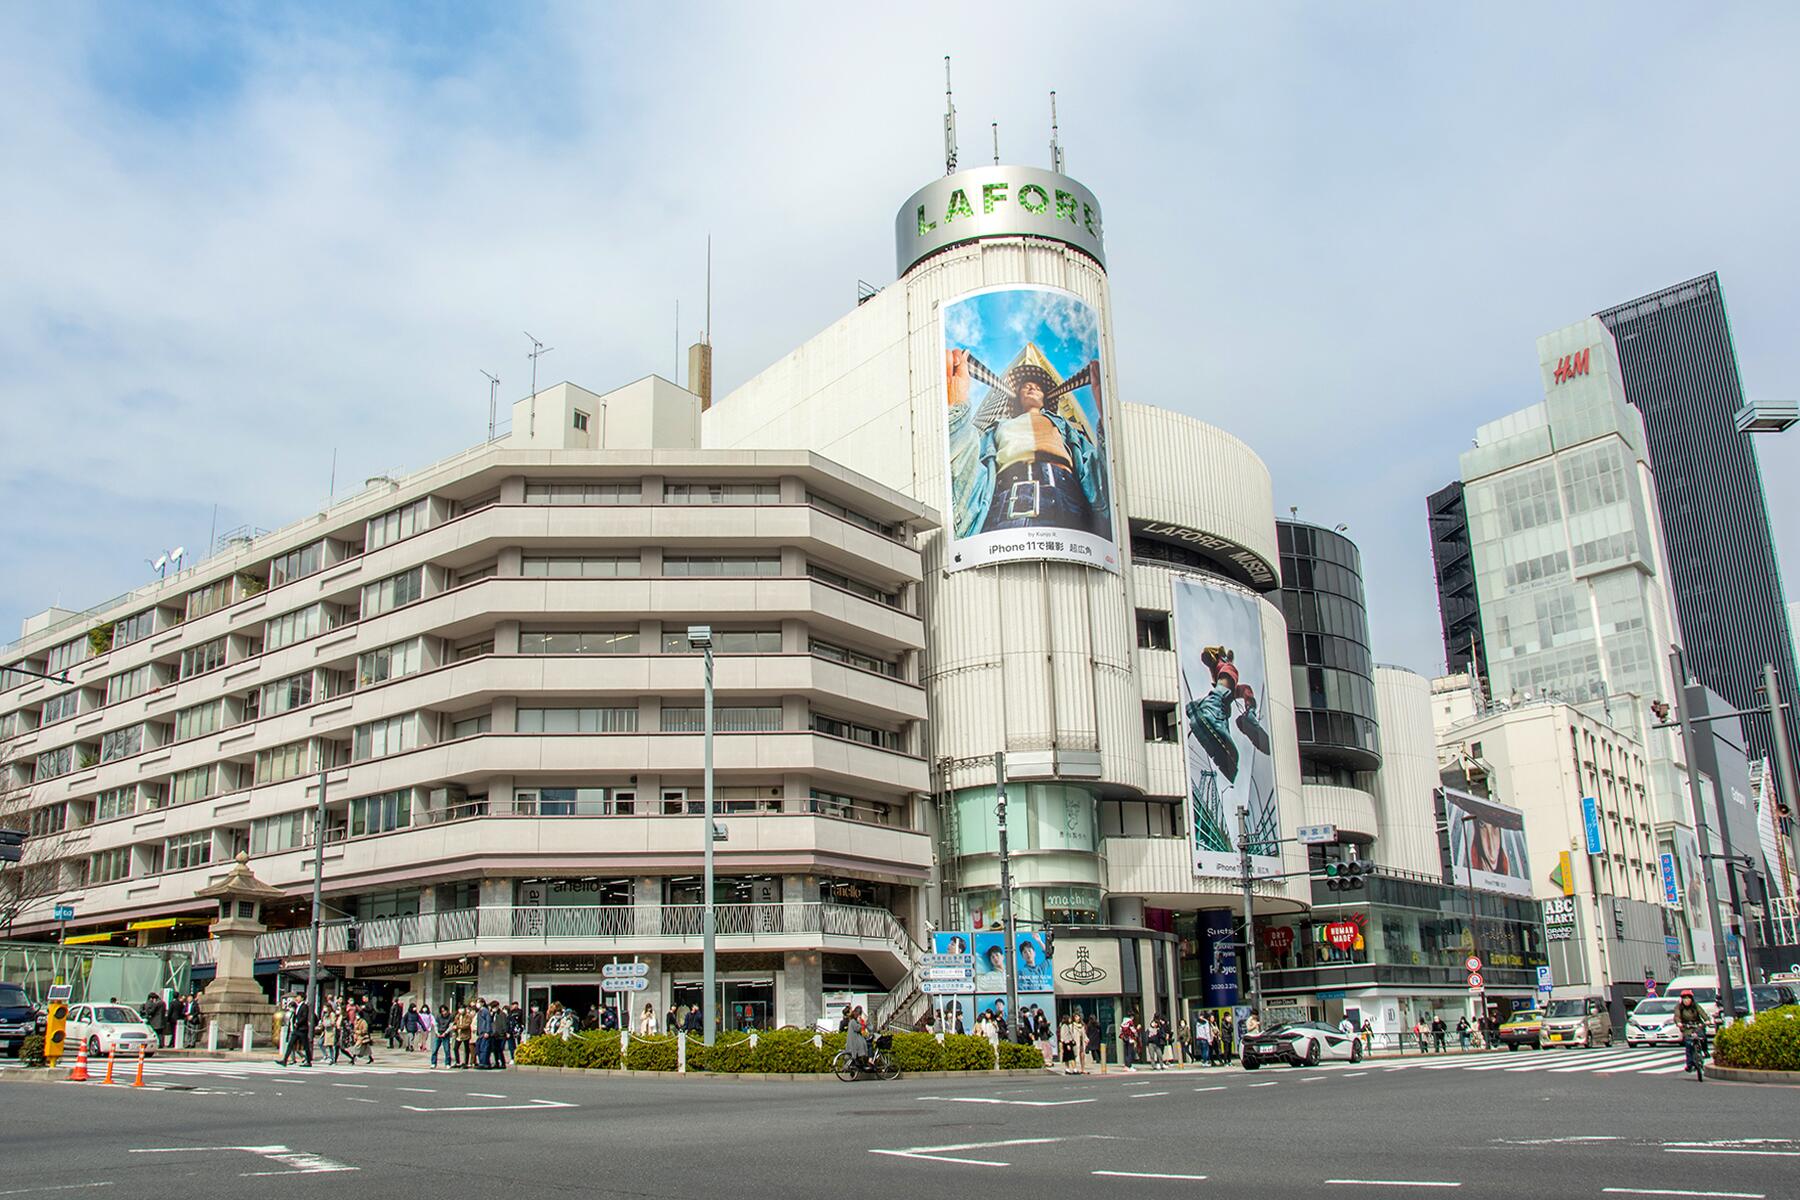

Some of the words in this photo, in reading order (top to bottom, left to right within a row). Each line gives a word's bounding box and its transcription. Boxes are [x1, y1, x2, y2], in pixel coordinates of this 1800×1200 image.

[1554, 348, 1590, 385] H&M
[989, 544, 1025, 555] iPhone
[1143, 523, 1234, 550] LAFORET
[1229, 551, 1273, 584] MUSEUM
[1545, 901, 1573, 914] ABC
[1545, 913, 1574, 925] MART
[1331, 926, 1353, 935] HUMAN
[1333, 934, 1352, 943] MADE
[1540, 968, 1547, 977] P
